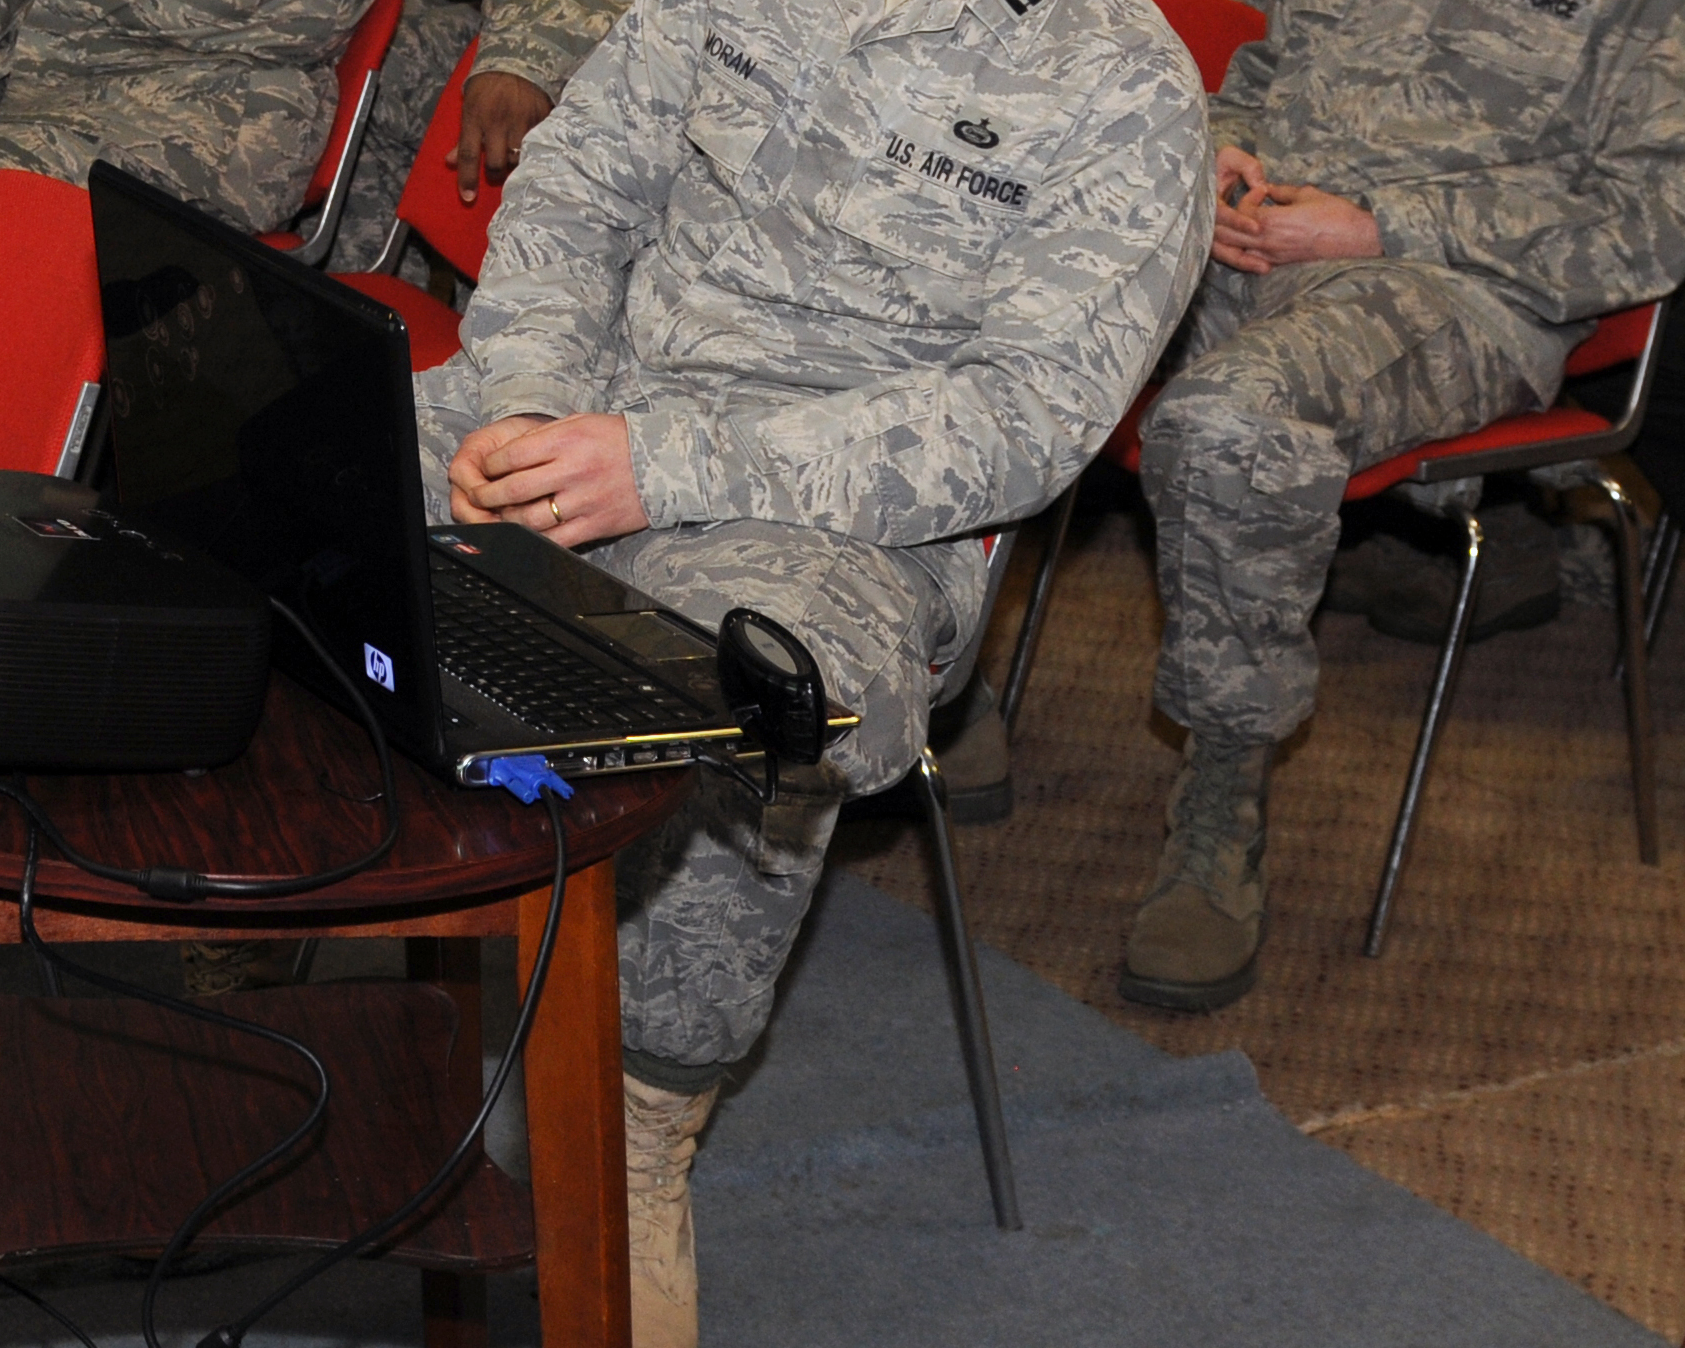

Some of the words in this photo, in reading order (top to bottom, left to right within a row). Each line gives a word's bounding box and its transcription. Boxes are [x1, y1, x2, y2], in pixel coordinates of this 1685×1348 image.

[705, 28, 758, 80] MORAN
[885, 135, 916, 168] U.S.
[919, 151, 954, 183] AIR
[955, 165, 1028, 205] FORCE
[371, 650, 387, 683] hp
